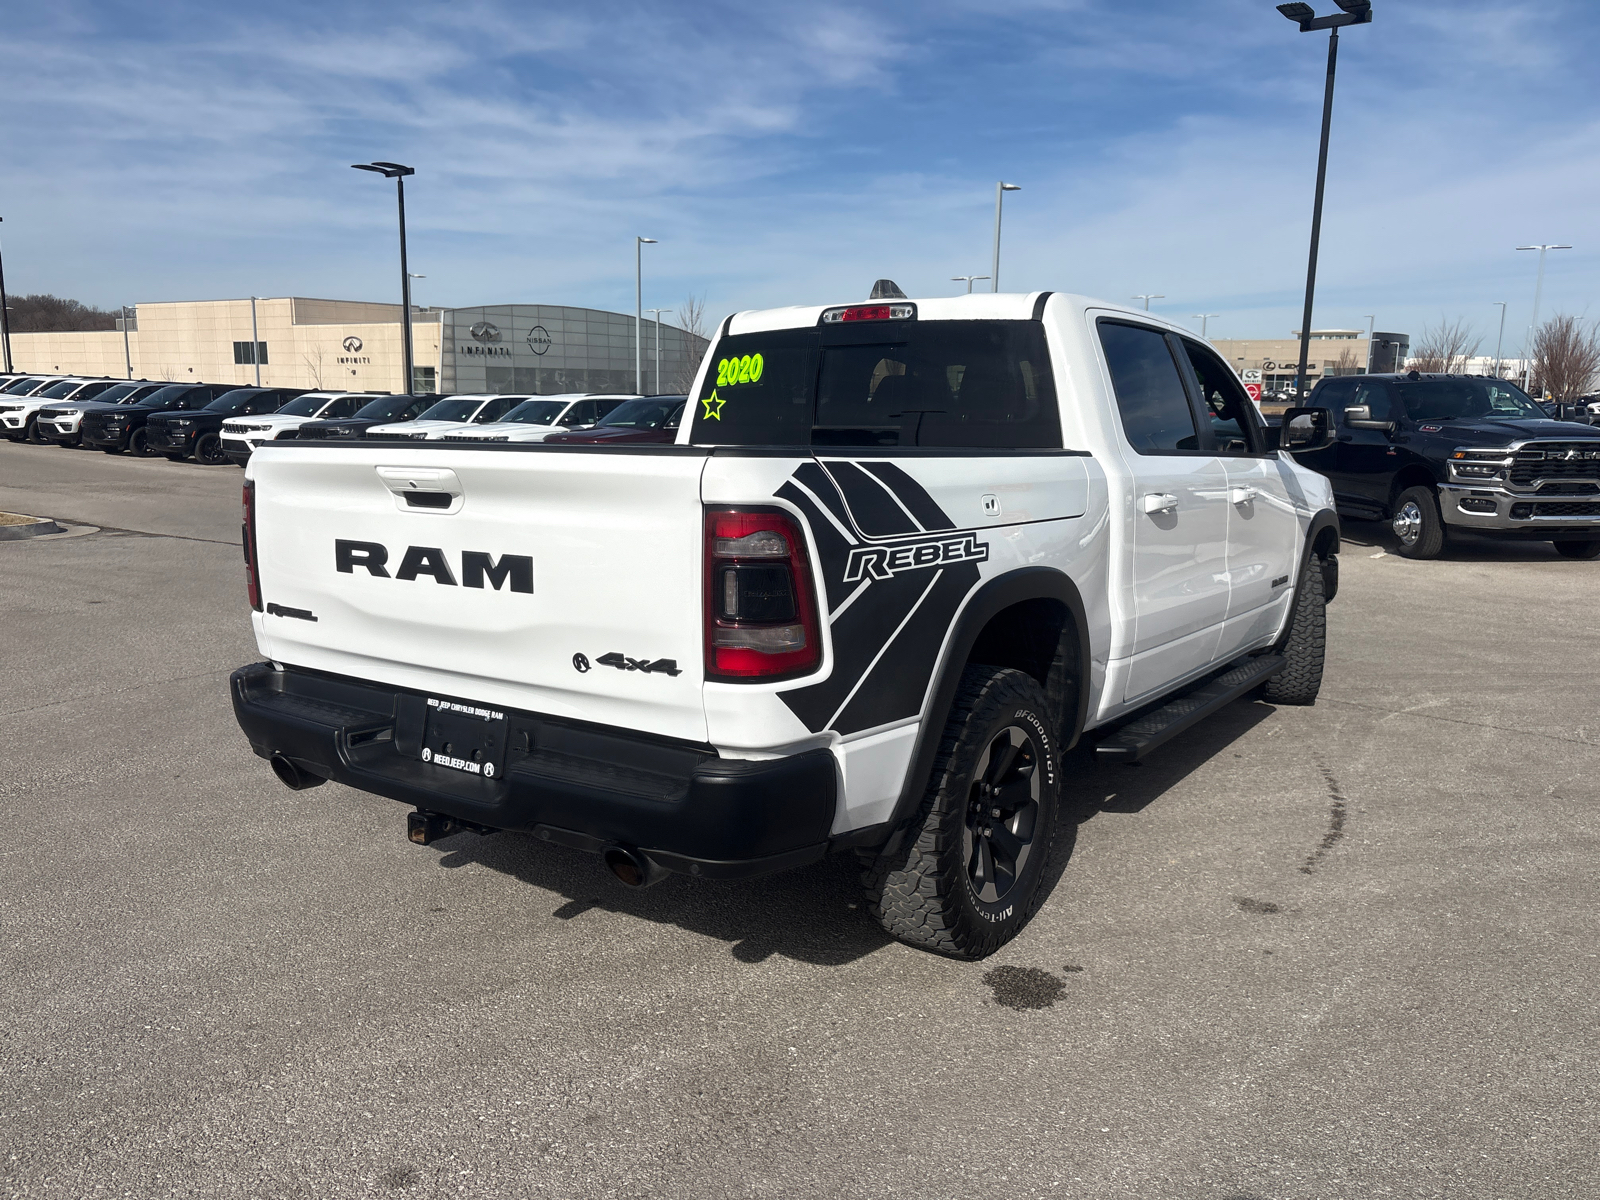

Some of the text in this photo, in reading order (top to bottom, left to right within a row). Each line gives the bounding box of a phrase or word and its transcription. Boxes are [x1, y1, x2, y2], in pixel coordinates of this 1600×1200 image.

[461, 346, 510, 356] INFINITI
[716, 353, 764, 387] 2020
[335, 538, 534, 594] RAM
[843, 534, 988, 583] REBEL
[427, 698, 504, 720] REED JEEP CHRYSLER DODGE RAM
[433, 753, 481, 774] REEDJEEP.COM
[1014, 709, 1054, 784] BFGoodrich
